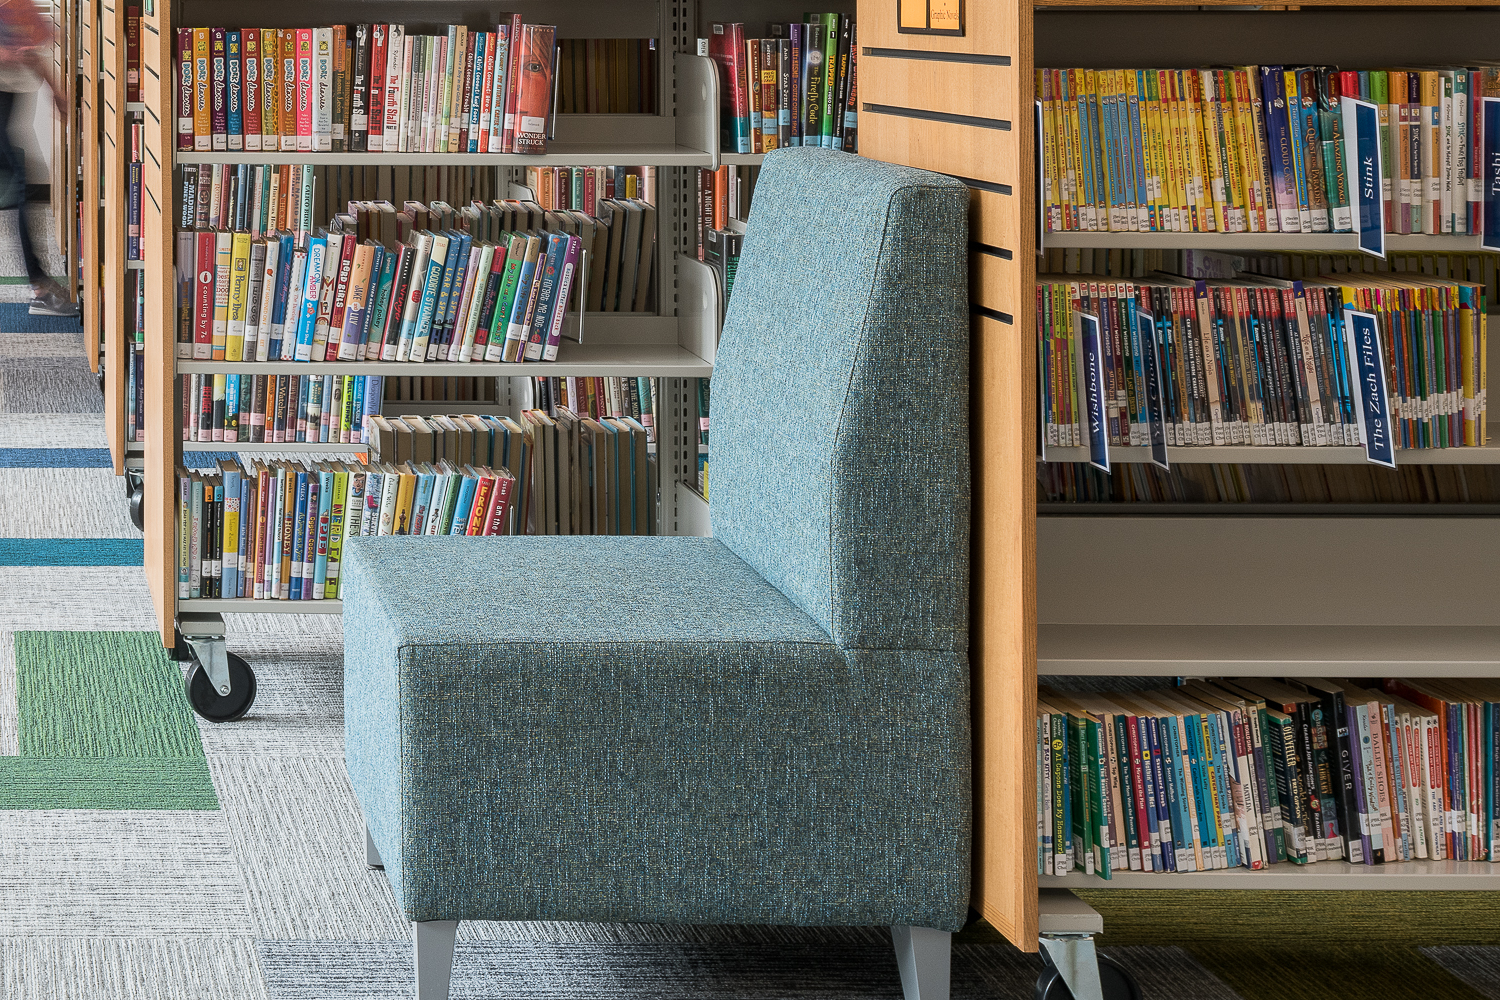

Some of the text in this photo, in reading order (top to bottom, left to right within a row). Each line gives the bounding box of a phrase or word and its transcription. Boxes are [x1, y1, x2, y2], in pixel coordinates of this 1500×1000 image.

[931, 9, 959, 22] Graphic Novels
[182, 62, 192, 116] DORK diaries
[230, 60, 240, 112] DORK diaries
[353, 75, 365, 106] The Fourth
[387, 75, 399, 125] The Fourth Stall
[808, 76, 820, 101] Firefly
[809, 103, 819, 124] Code
[1281, 138, 1289, 166] CLOUD
[1284, 168, 1293, 195] CASTLE
[1337, 173, 1345, 204] VOYAGE
[1364, 156, 1374, 199] Stink
[1492, 152, 1500, 196] Tashi
[187, 184, 195, 226] MADMAN
[443, 267, 453, 288] LIAR
[455, 267, 465, 288] LIAR
[374, 289, 387, 328] hokey pokey
[393, 284, 408, 322] Wringer
[422, 266, 441, 334] GOODBYE STRANGER
[438, 301, 446, 316] SPY
[449, 300, 458, 315] SPY
[200, 320, 207, 329] by
[277, 387, 285, 420] Watcher
[1089, 352, 1100, 434] Wishbone
[1362, 327, 1384, 451] The Zach Files
[472, 486, 487, 536] FRONT
[284, 520, 292, 552] HONEY
[319, 523, 328, 549] PIE
[1284, 739, 1296, 767] YELLER
[1373, 733, 1386, 803] BALLET SHOES
[1341, 750, 1352, 790] GIVER
[1242, 784, 1251, 812] MATILDA
